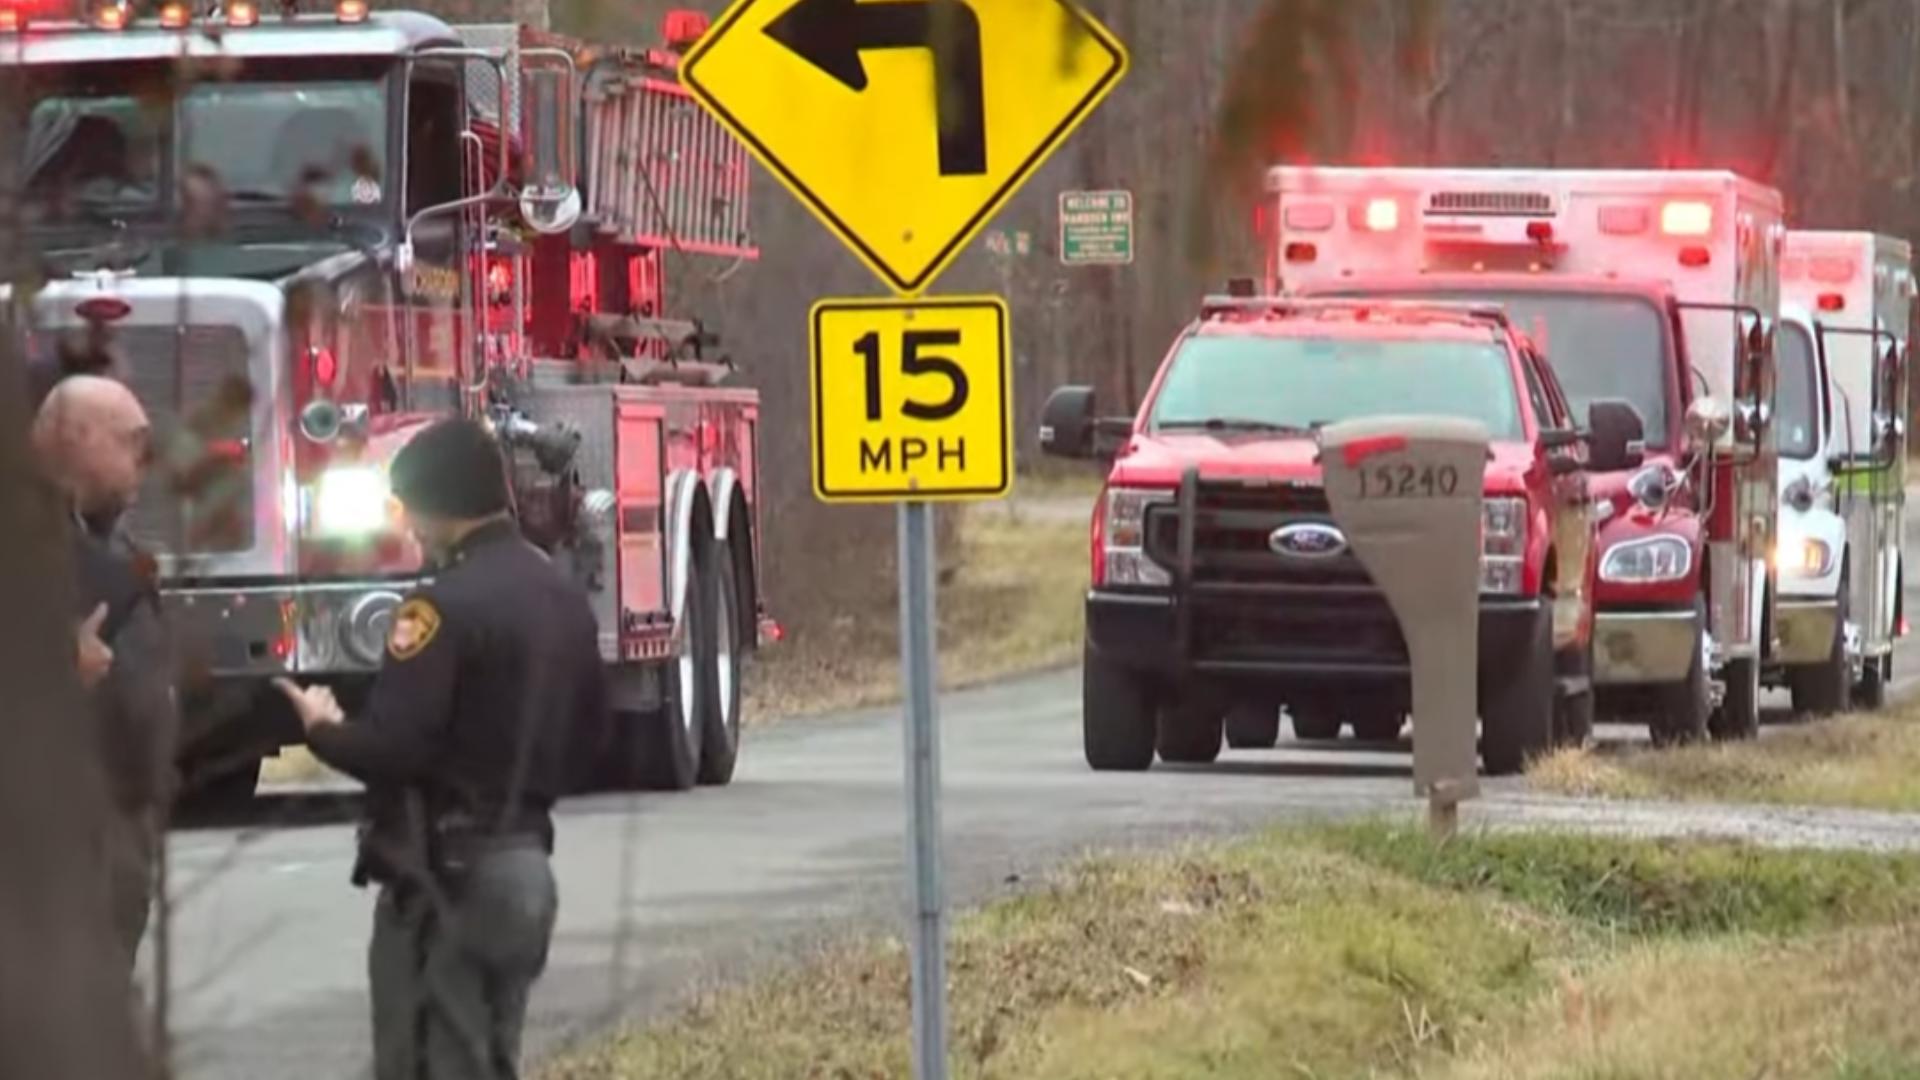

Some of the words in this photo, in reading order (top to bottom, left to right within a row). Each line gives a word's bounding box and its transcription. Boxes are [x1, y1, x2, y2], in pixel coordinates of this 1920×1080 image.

[852, 329, 970, 422] 15
[859, 436, 966, 474] MPH
[1357, 463, 1459, 499] 15240
